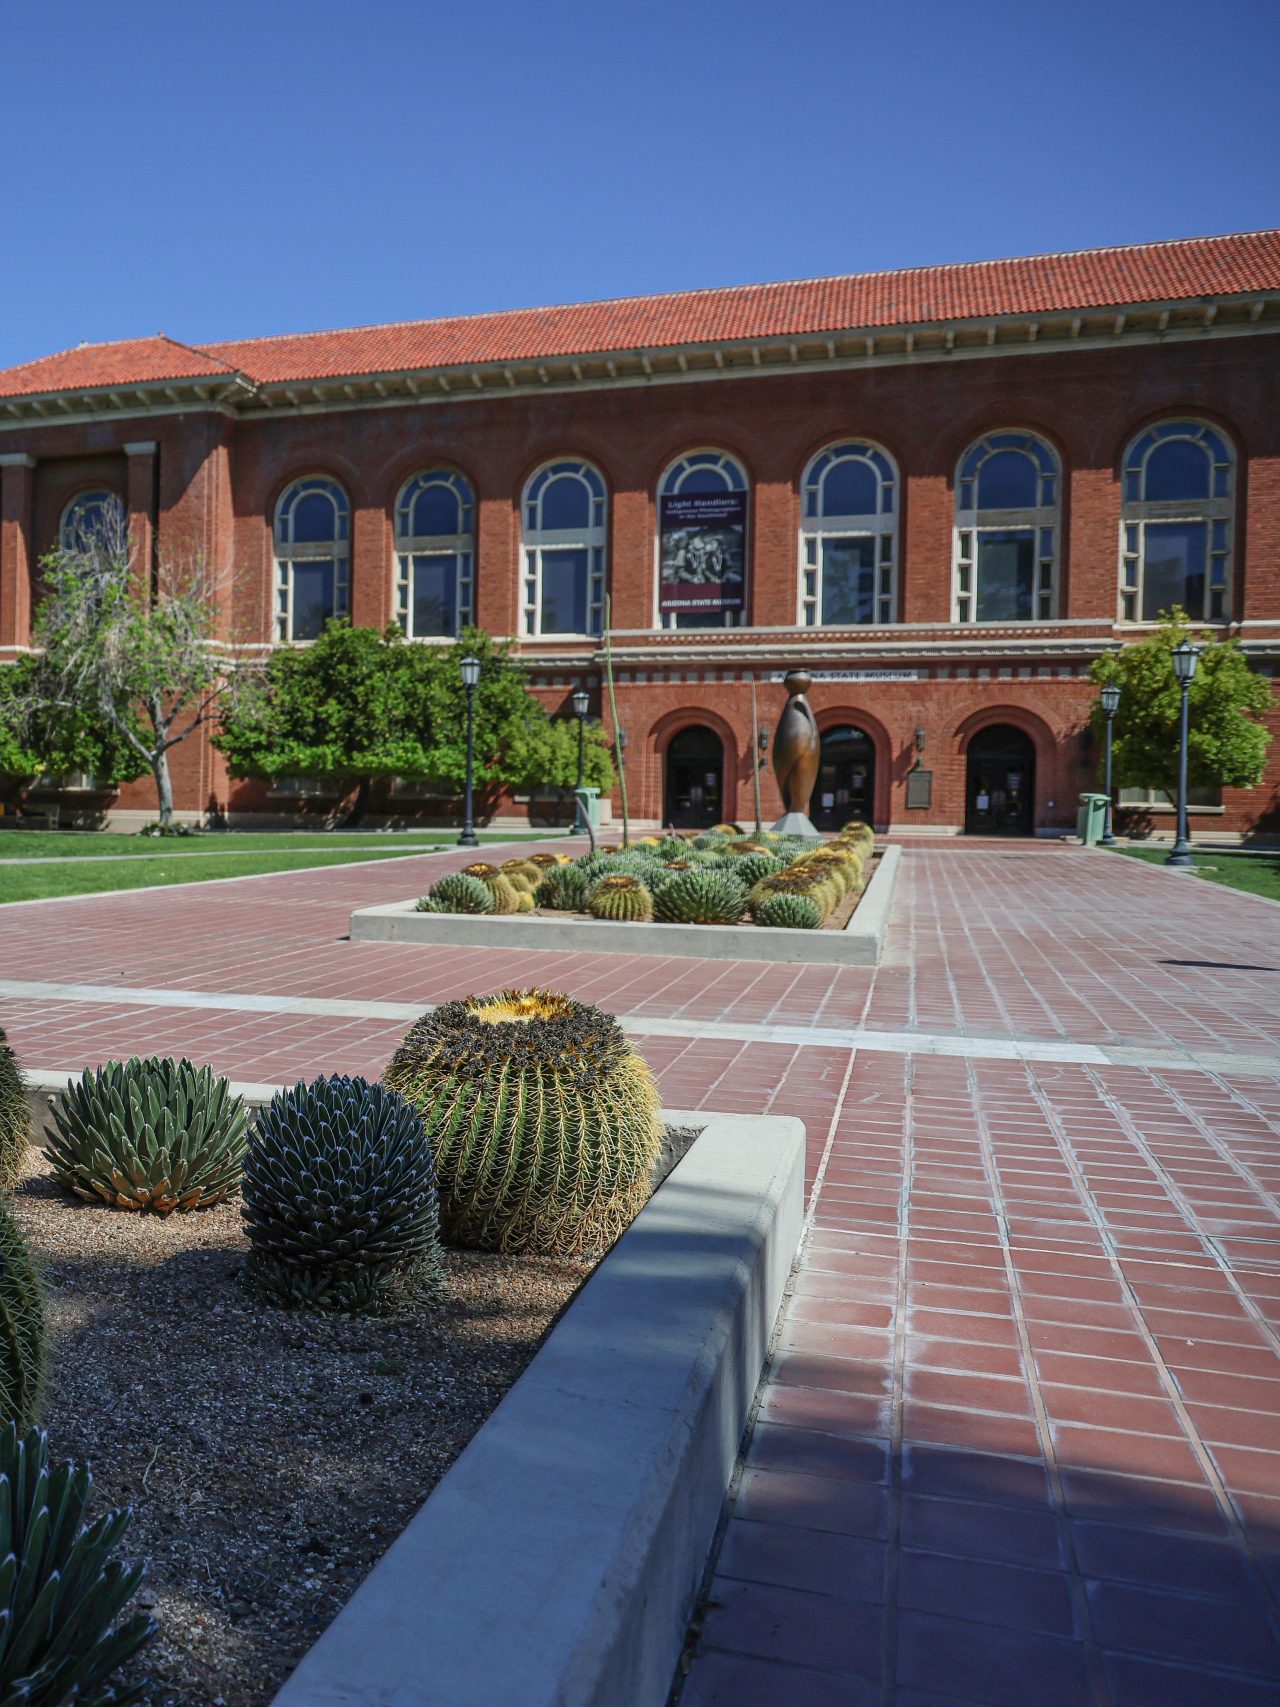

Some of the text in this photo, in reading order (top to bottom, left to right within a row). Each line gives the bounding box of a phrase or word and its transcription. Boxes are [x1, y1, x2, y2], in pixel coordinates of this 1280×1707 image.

[661, 600, 691, 608] ARIZONA
[691, 599, 711, 607] STATE
[864, 670, 913, 679] MUSEUM
